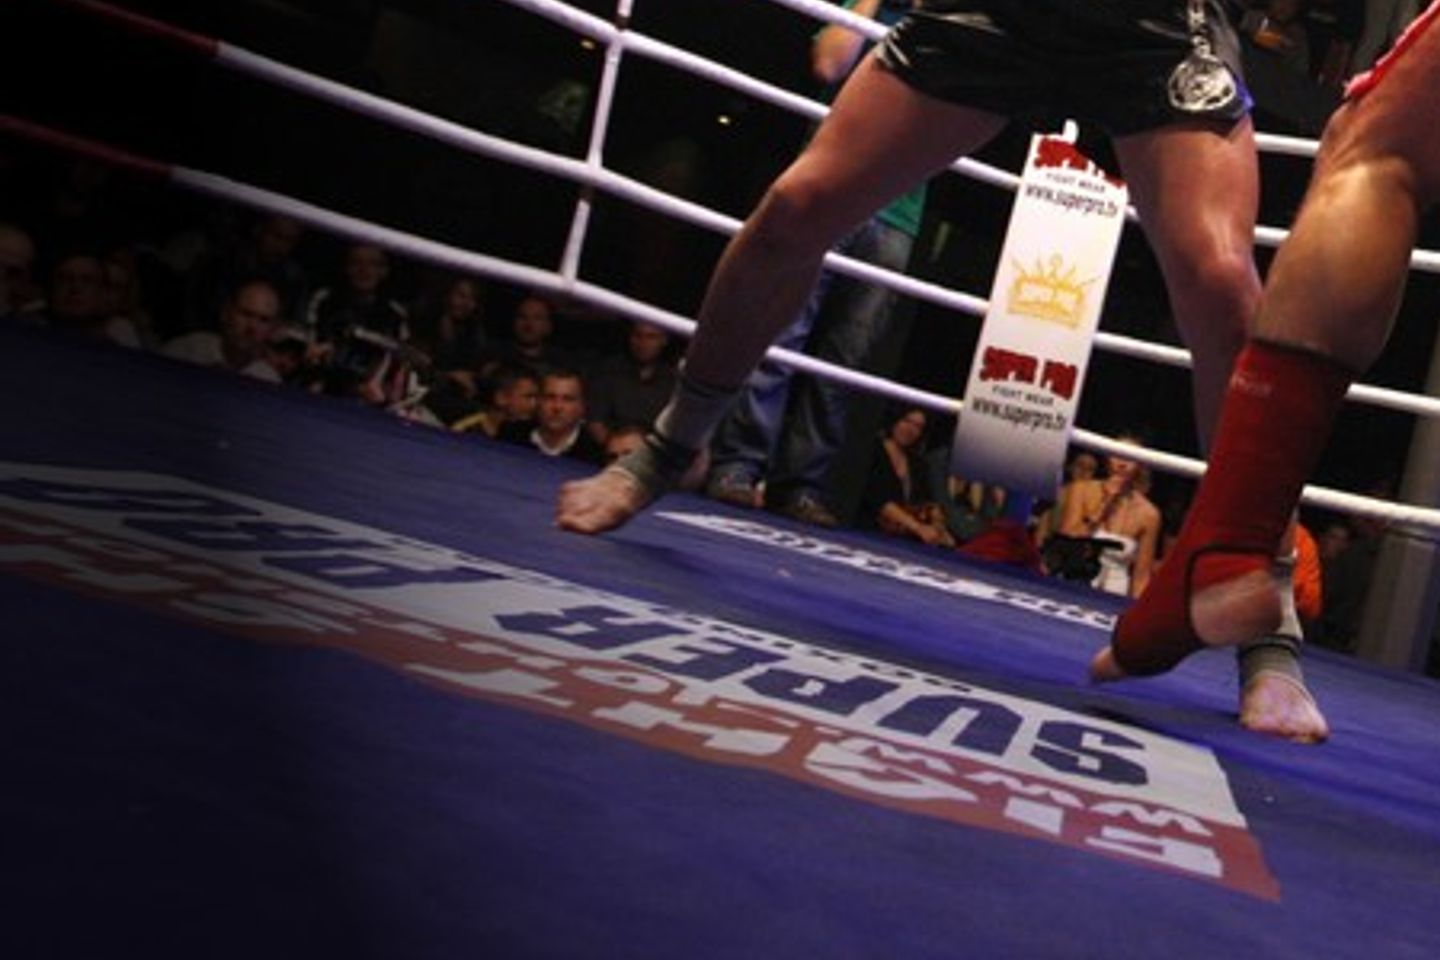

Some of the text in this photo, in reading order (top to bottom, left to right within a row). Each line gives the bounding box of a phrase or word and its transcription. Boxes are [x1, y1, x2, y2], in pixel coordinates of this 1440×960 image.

[979, 345, 1078, 401] SUPER PRO
[404, 661, 1224, 879] FIGHT
[492, 605, 1149, 786] SUPER
